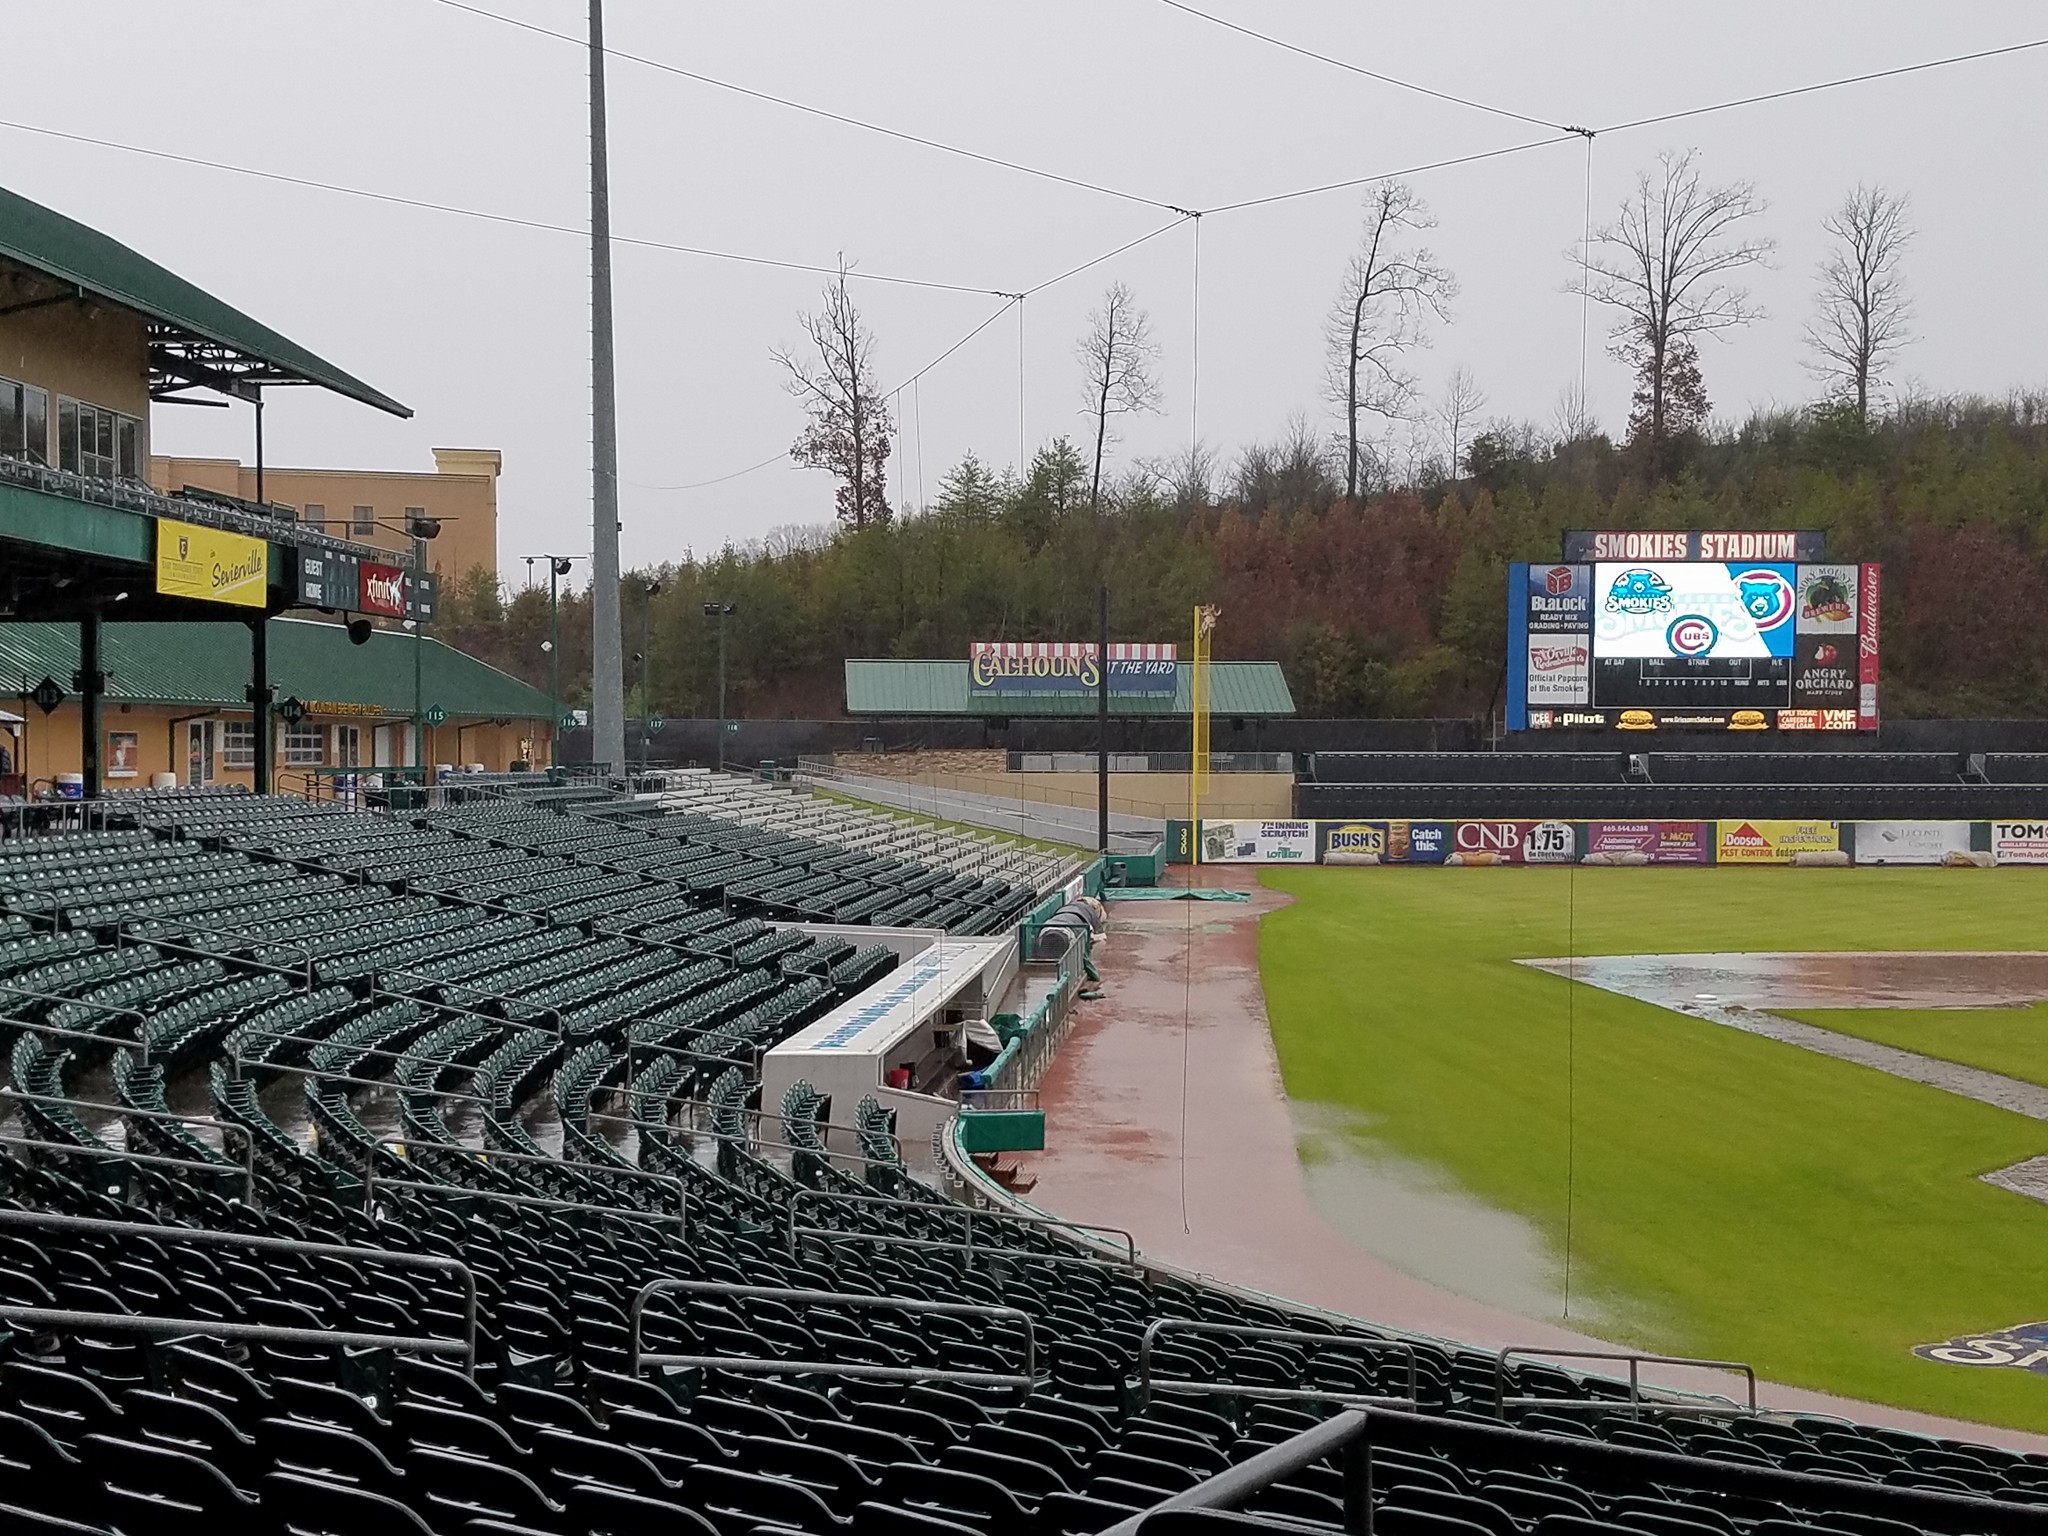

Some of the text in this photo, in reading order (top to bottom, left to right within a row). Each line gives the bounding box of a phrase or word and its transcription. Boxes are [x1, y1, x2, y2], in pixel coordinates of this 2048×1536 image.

[1595, 533, 1795, 558] SMOKIES STADIUM
[211, 548, 262, 588] Sevierville
[305, 558, 323, 576] GUEST
[366, 573, 394, 606] xfinity
[1798, 567, 1857, 600] SMOKY MOUNTAIN
[1605, 595, 1672, 613] SMOKIES
[1860, 567, 1878, 658] Budweiser
[972, 646, 1100, 687] CALHOUN'S
[1120, 661, 1144, 674] THE
[1145, 661, 1175, 674] YARD
[1529, 674, 1588, 684] Official Popcorn
[1803, 668, 1847, 679] ANGRY
[1539, 684, 1550, 692] the
[1552, 684, 1584, 692] Smokies
[1795, 679, 1854, 690] ORCHARD
[38, 688, 58, 703] 113
[284, 705, 301, 717] 114
[428, 712, 444, 720] 115
[1823, 709, 1857, 720] VMF
[1563, 713, 1605, 726] Pilot
[1822, 720, 1857, 729] .com
[1261, 830, 1309, 838] SCRATCH!
[1411, 828, 1442, 840] Catch
[1457, 822, 1519, 849] CNB
[1796, 826, 1817, 834] FREE
[1331, 832, 1381, 849] BUSH'S
[1415, 840, 1438, 851] this.
[1720, 848, 1738, 857] PEST
[1741, 848, 1773, 857] CONTROL
